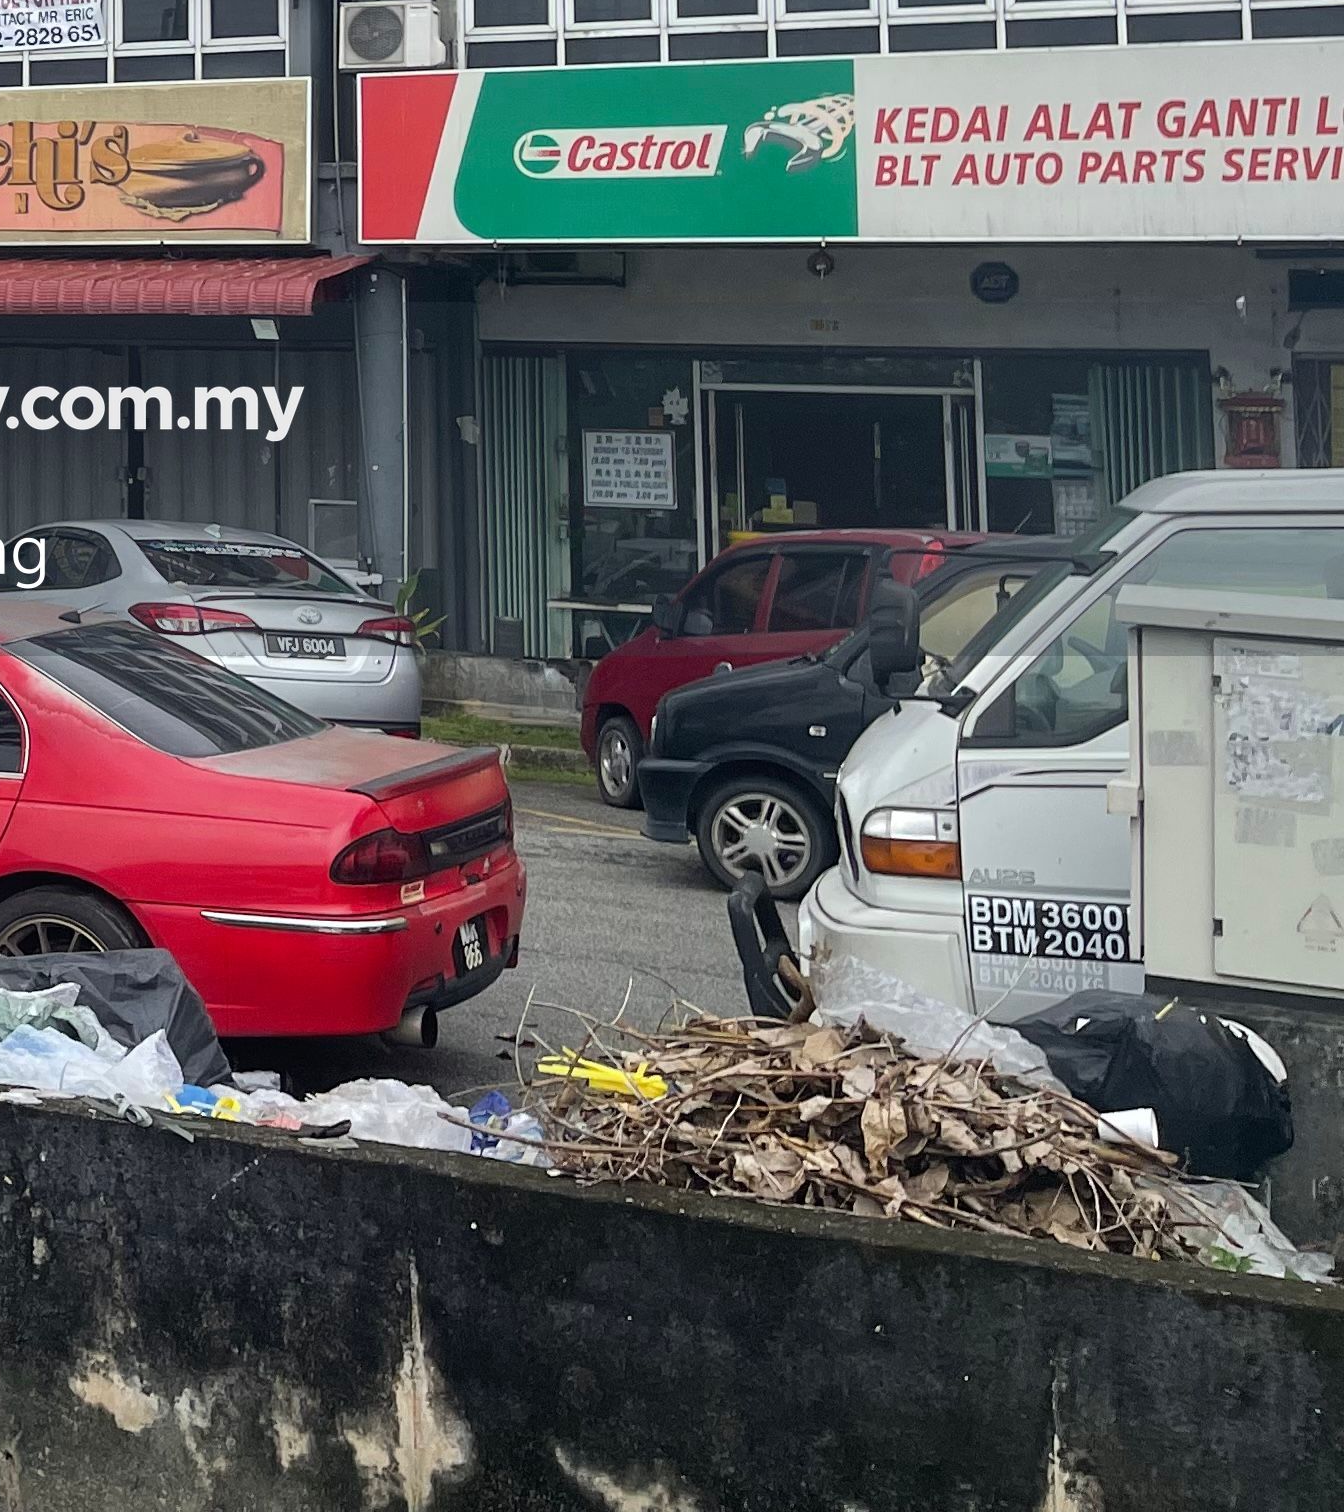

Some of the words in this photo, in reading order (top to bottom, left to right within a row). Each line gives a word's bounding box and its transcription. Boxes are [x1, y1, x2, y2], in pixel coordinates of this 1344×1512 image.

[38, 10, 61, 23] MR.
[65, 7, 94, 22] ERIC
[67, 23, 101, 43] 651
[874, 104, 1010, 147] KEDAI
[1025, 100, 1143, 143] ALAT
[1157, 96, 1300, 138] GANTI
[1316, 96, 1344, 135] L
[566, 131, 715, 175] Castrol
[874, 153, 936, 189] BLT
[951, 150, 1062, 188] AUTO
[1078, 148, 1206, 185] PARTS
[277, 637, 300, 653] VFJ
[303, 638, 336, 654] 6004
[970, 896, 1035, 927] BDM
[1042, 902, 1123, 932] 3600
[972, 924, 1038, 954] BTM
[1044, 929, 1125, 960] 2040
